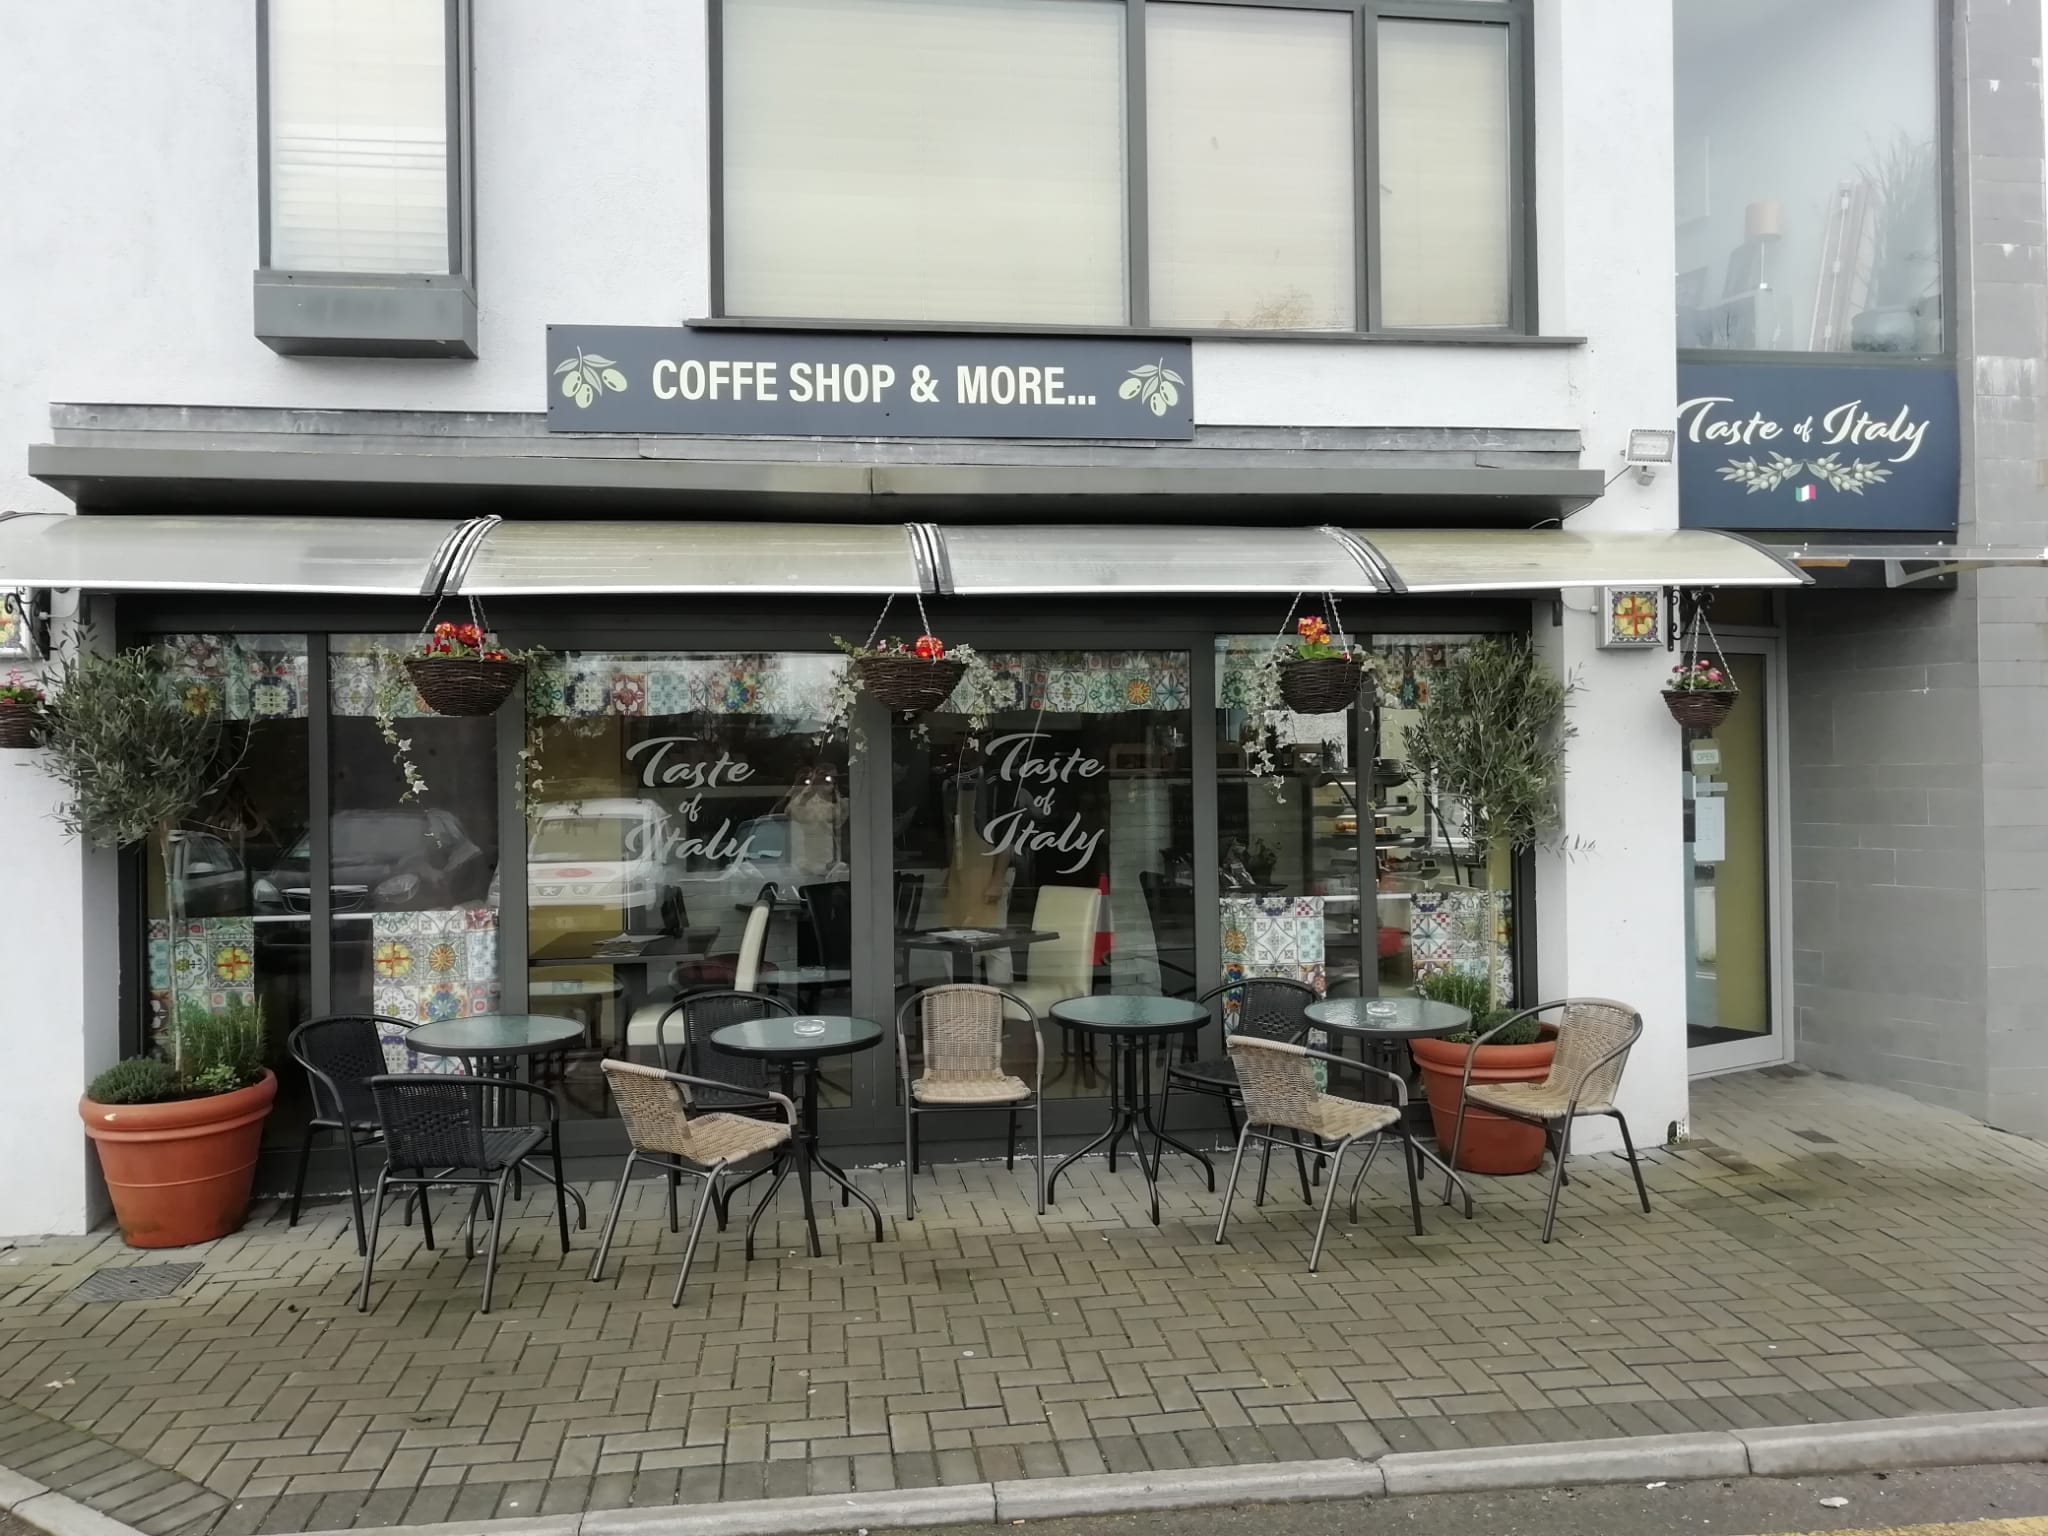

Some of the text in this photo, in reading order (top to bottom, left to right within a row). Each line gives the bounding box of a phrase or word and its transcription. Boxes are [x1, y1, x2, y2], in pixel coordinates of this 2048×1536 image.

[652, 359, 1097, 405] COFFE SHOP & MORE...
[1677, 397, 1930, 462] Taste of Italy
[626, 736, 756, 789] Taste
[984, 733, 1105, 784] Taste
[678, 792, 703, 822] of
[1033, 787, 1056, 816] of
[622, 814, 757, 881] Italy
[980, 807, 1105, 874] Italy
